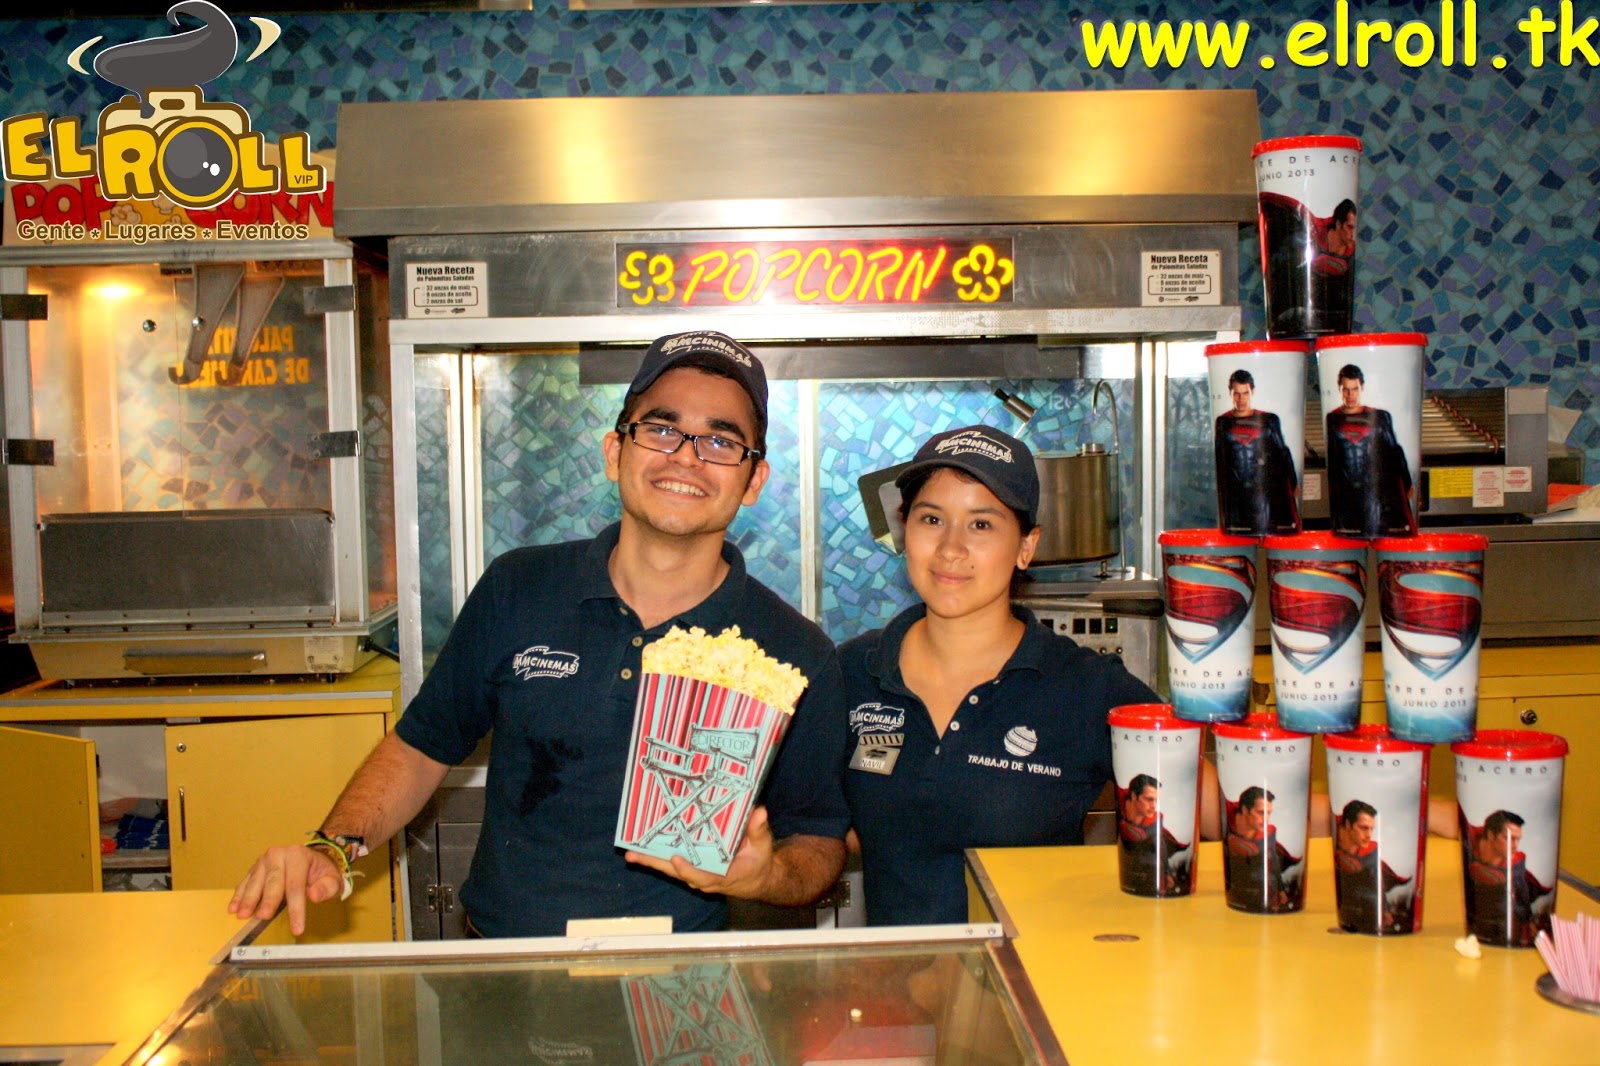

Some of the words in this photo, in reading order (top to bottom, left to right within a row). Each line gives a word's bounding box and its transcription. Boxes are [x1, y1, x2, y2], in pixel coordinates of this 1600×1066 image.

[1288, 169, 1315, 178] 2013
[1151, 255, 1177, 263] Nueva
[1179, 254, 1208, 263] Receta
[416, 266, 443, 275] Nueva
[445, 265, 475, 275] Receta
[683, 247, 946, 303] POPCORN
[512, 655, 577, 673] MMCINEMAS
[1172, 680, 1197, 689] JUNIO
[1281, 692, 1307, 701] JUNIO
[1313, 693, 1338, 701] 2013
[1403, 700, 1438, 709] JUNIO
[1443, 700, 1467, 708] 2013
[697, 733, 751, 752] DIRECTOR
[1124, 733, 1183, 743] ACERO
[1234, 744, 1296, 754] ACERO
[968, 754, 1009, 769] TRABAJO
[1011, 761, 1025, 772] DE
[1027, 763, 1062, 778] VERANO
[1336, 755, 1401, 768] ACERO
[1479, 764, 1548, 775] ACERO
